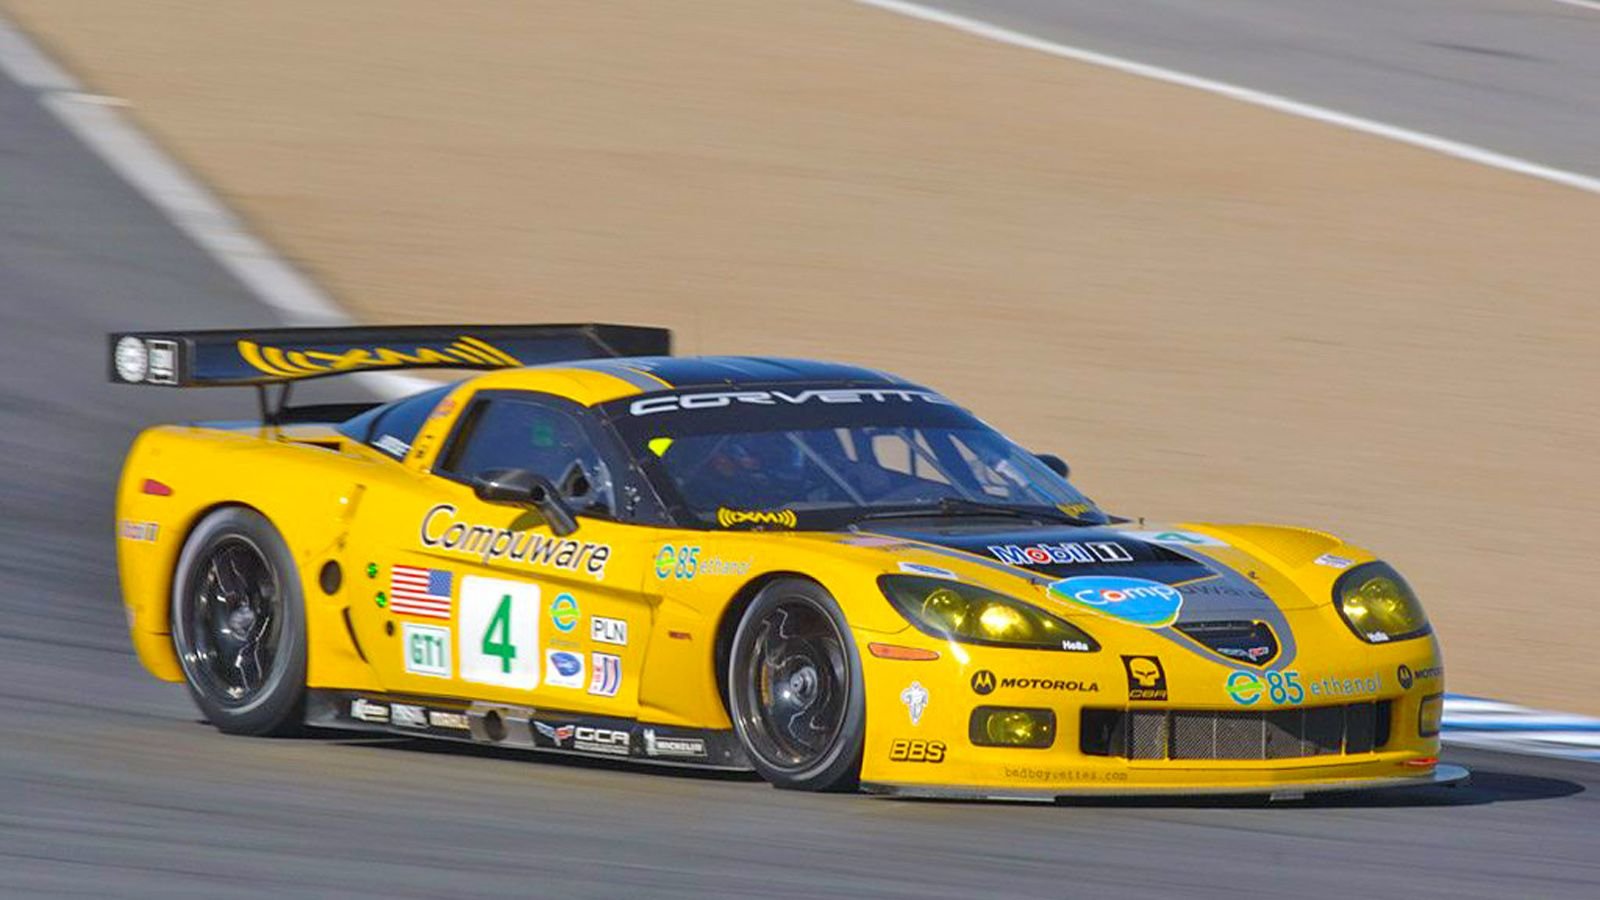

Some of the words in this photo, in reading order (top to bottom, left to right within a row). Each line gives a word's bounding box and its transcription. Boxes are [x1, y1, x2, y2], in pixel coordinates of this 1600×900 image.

[629, 389, 950, 416] CORVETTE
[420, 503, 610, 574] Compuware
[988, 545, 1093, 564] Mobil
[482, 594, 516, 674] 4
[593, 619, 625, 641] PLN
[410, 633, 445, 668] GT1
[1001, 677, 1099, 692] MOTOROLA
[1310, 673, 1382, 696] ethanol
[575, 726, 630, 744] GCA
[890, 739, 946, 763] BBS
